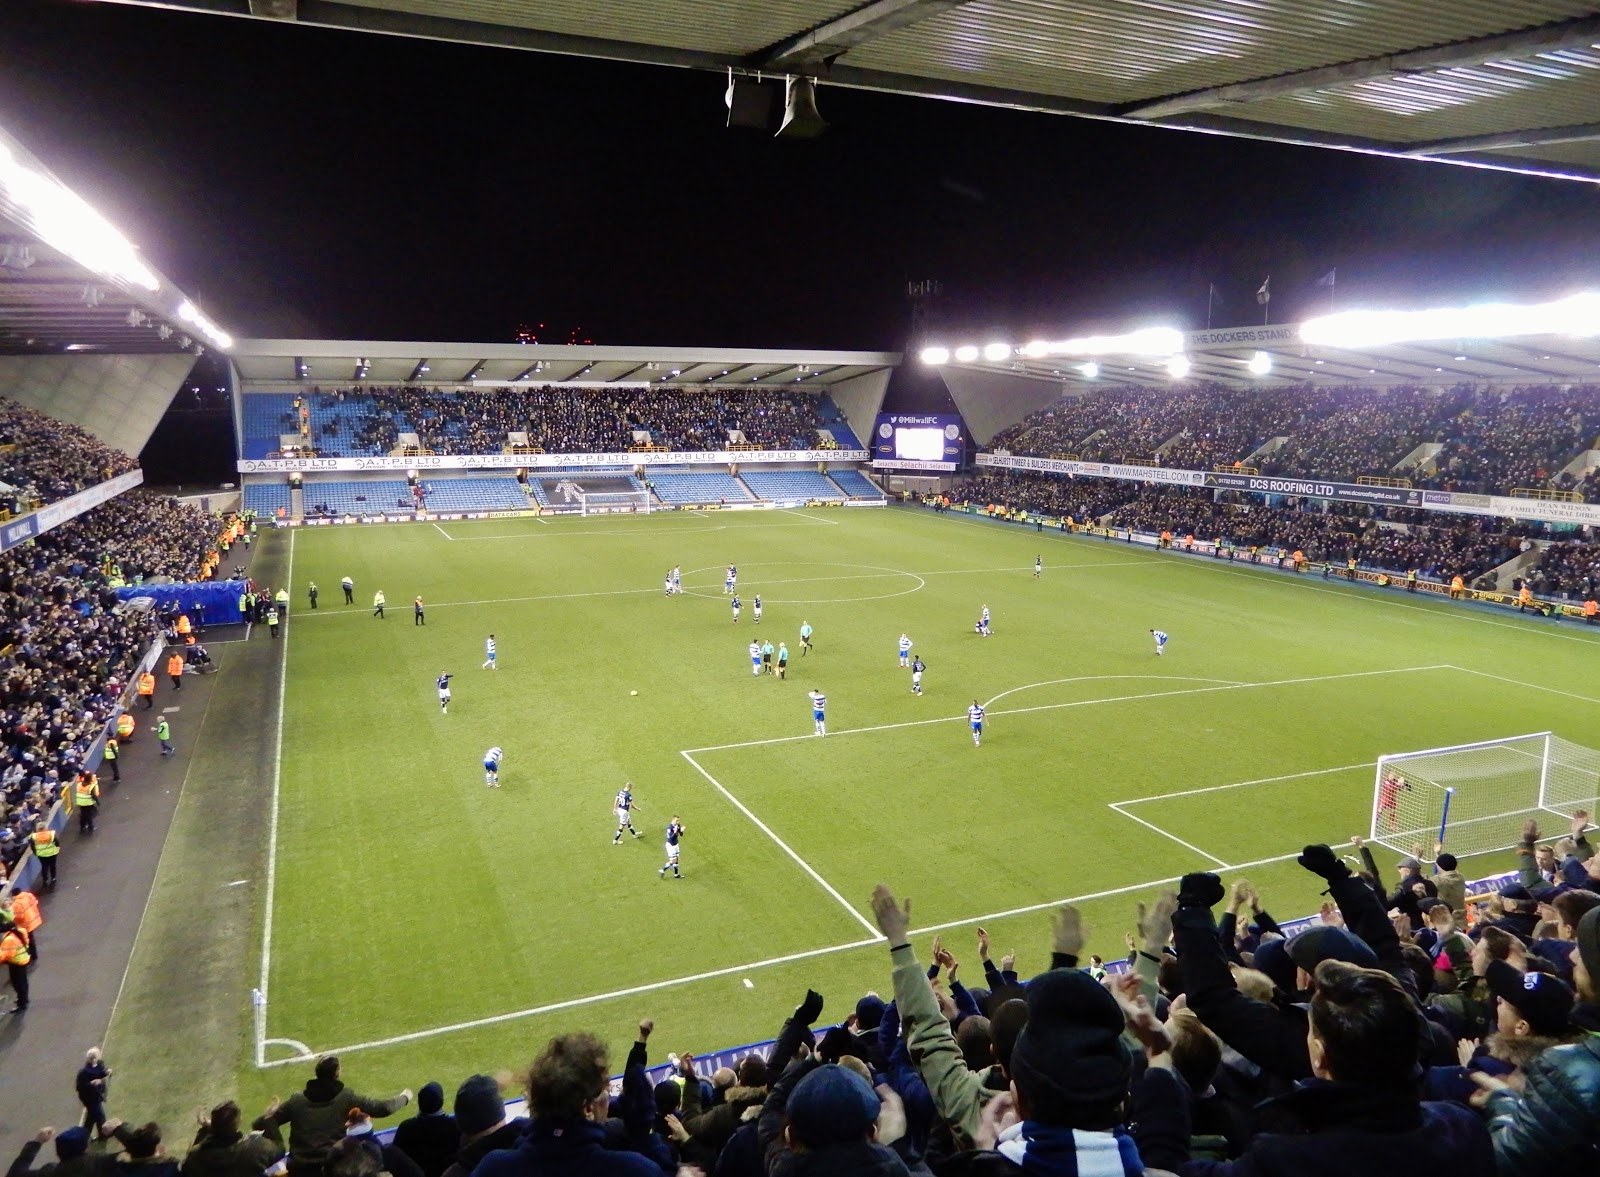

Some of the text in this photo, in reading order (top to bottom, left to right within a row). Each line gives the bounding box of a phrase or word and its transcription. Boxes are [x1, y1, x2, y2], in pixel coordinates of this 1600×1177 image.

[1192, 329, 1294, 344] THE DOCKERS STAND
[992, 456, 1011, 465] SELHURST
[1012, 458, 1026, 467] TIMBER
[1031, 459, 1051, 469] BUILDERS
[1052, 462, 1079, 472] MERCHANTS
[1112, 467, 1189, 481] WWW.MAHSTEEL.COM
[1250, 479, 1334, 496] DCS ROOFING LTD
[1338, 490, 1400, 500] www.dcsroofingltd.co.uk
[1539, 508, 1572, 517] FUNERAL
[1563, 605, 1587, 616] energ
